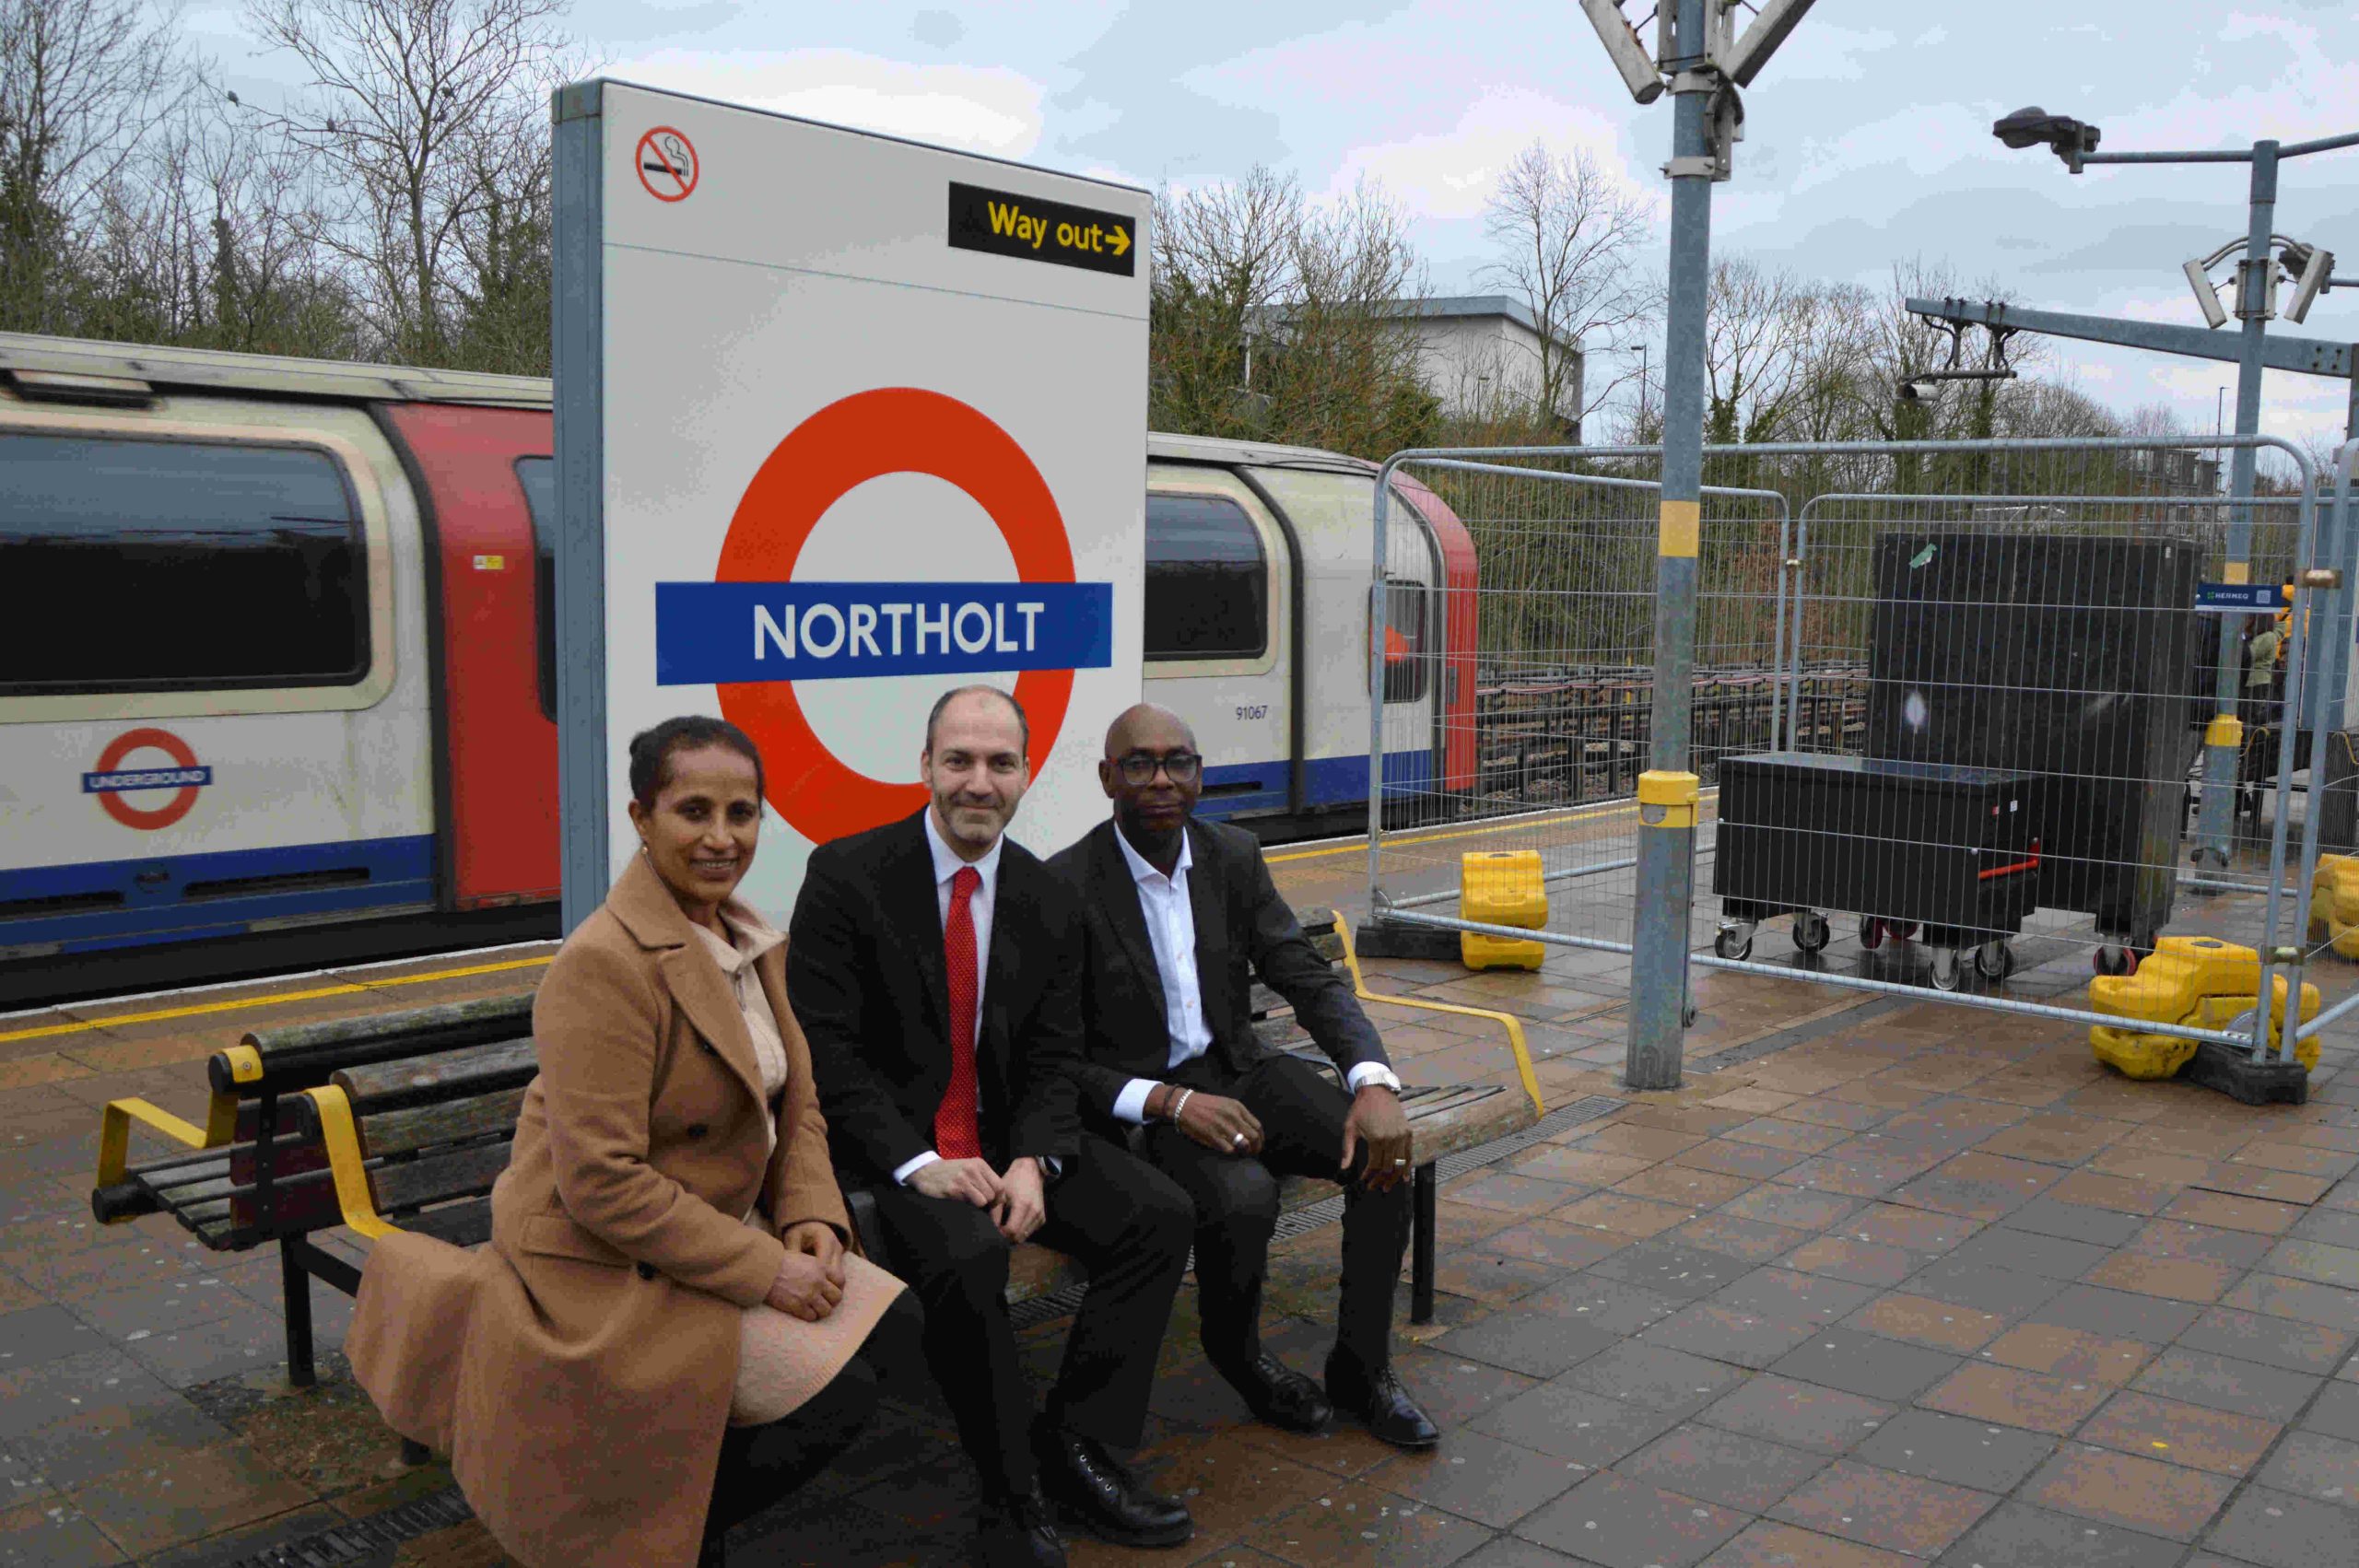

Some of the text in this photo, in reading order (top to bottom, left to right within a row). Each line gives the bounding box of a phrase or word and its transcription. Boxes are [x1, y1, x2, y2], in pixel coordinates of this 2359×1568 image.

[988, 200, 1104, 253] Way out
[754, 602, 1045, 661] NORTHOLT
[1235, 705, 1268, 720] 91067
[88, 770, 206, 788] UNDERGROUND
